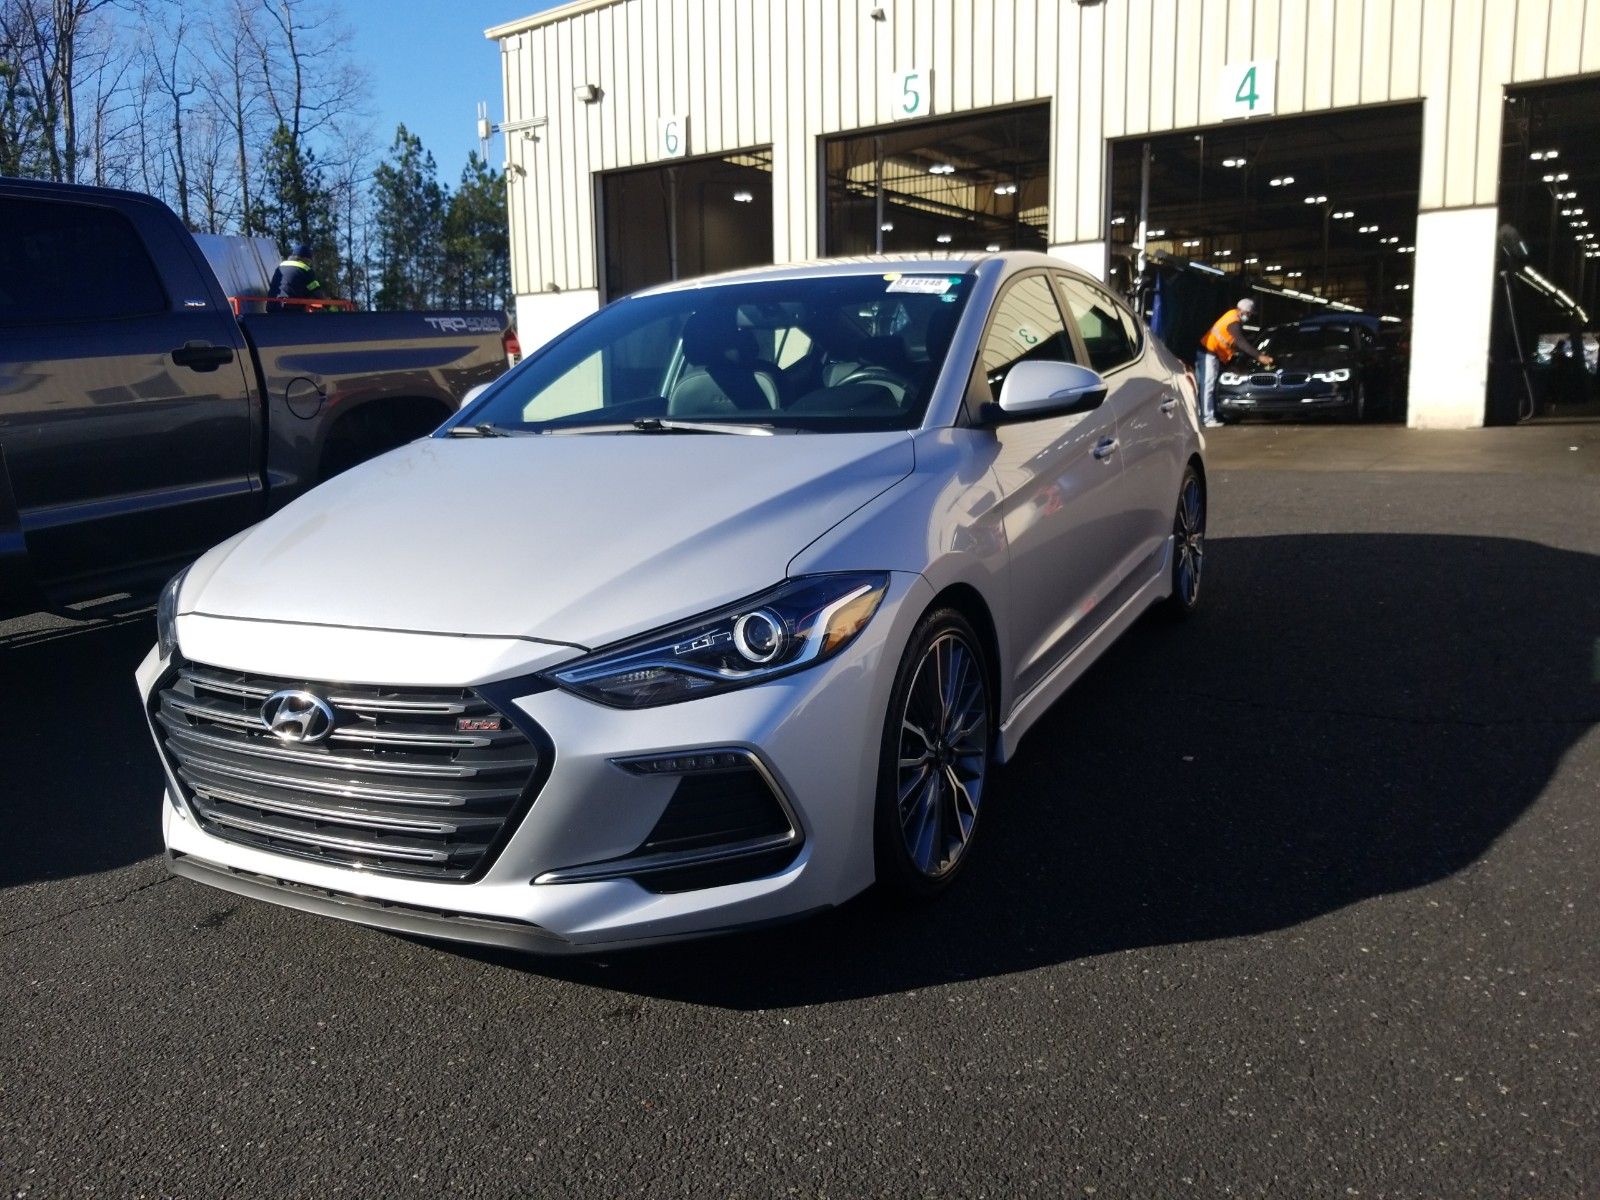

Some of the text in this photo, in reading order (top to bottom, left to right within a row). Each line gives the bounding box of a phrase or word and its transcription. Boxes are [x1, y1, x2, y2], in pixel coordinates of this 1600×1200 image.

[902, 74, 920, 114] 5
[1235, 66, 1260, 110] 4
[665, 121, 678, 154] 6
[424, 317, 467, 332] TRD
[459, 719, 500, 730] Turbo
